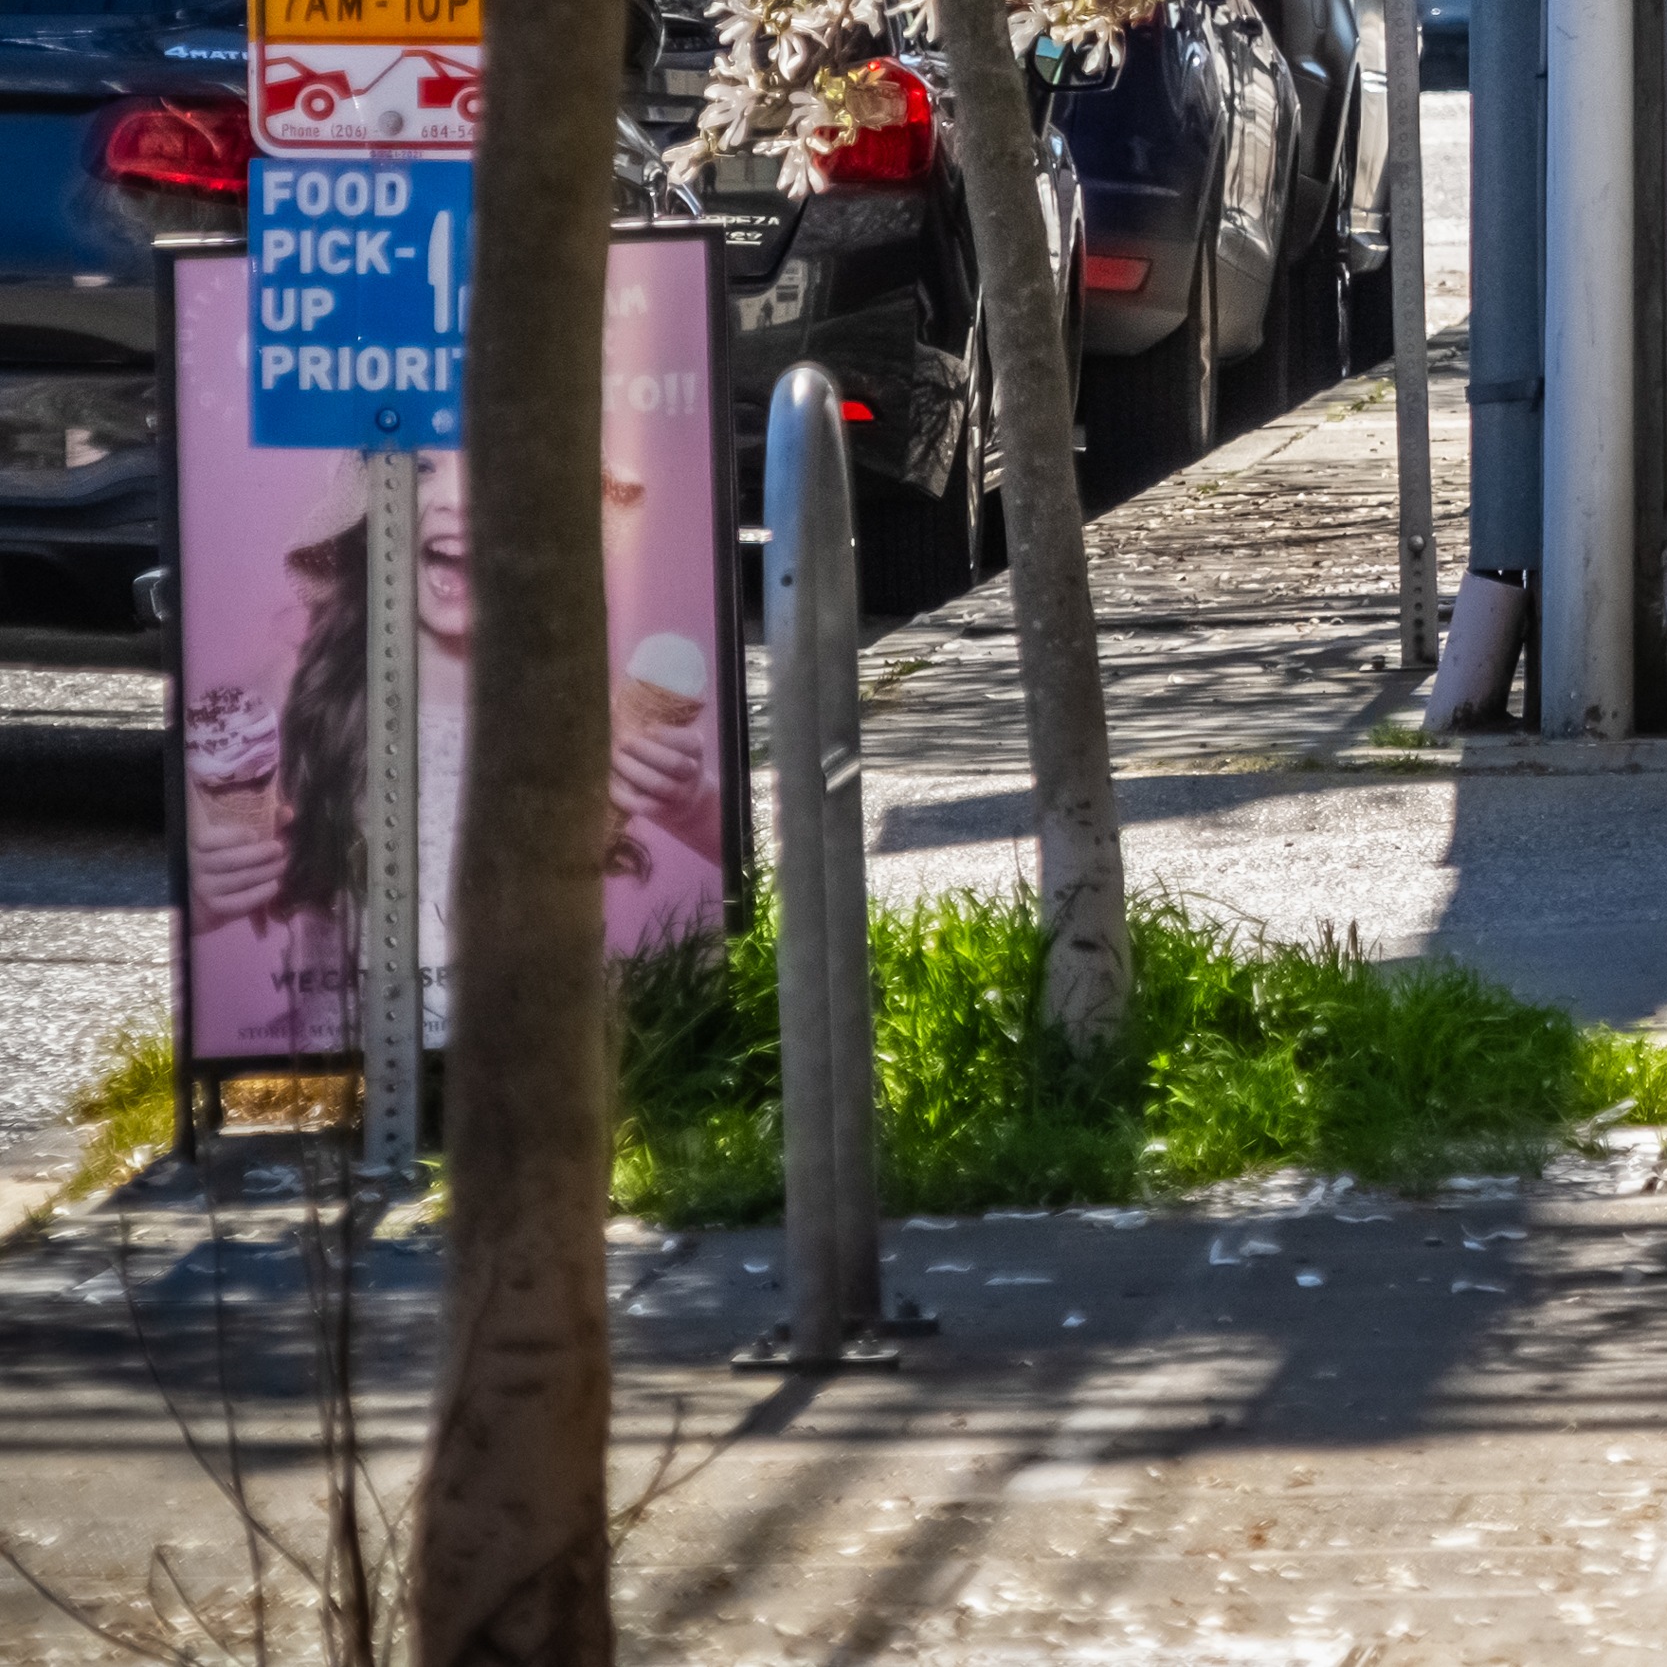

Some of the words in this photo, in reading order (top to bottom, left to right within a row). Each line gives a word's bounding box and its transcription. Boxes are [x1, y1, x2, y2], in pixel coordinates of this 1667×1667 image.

[281, 123, 320, 138] Phone
[330, 123, 368, 140] (206)
[263, 172, 410, 217] FOOD
[263, 230, 416, 275] PICK-
[261, 287, 336, 332] UP
